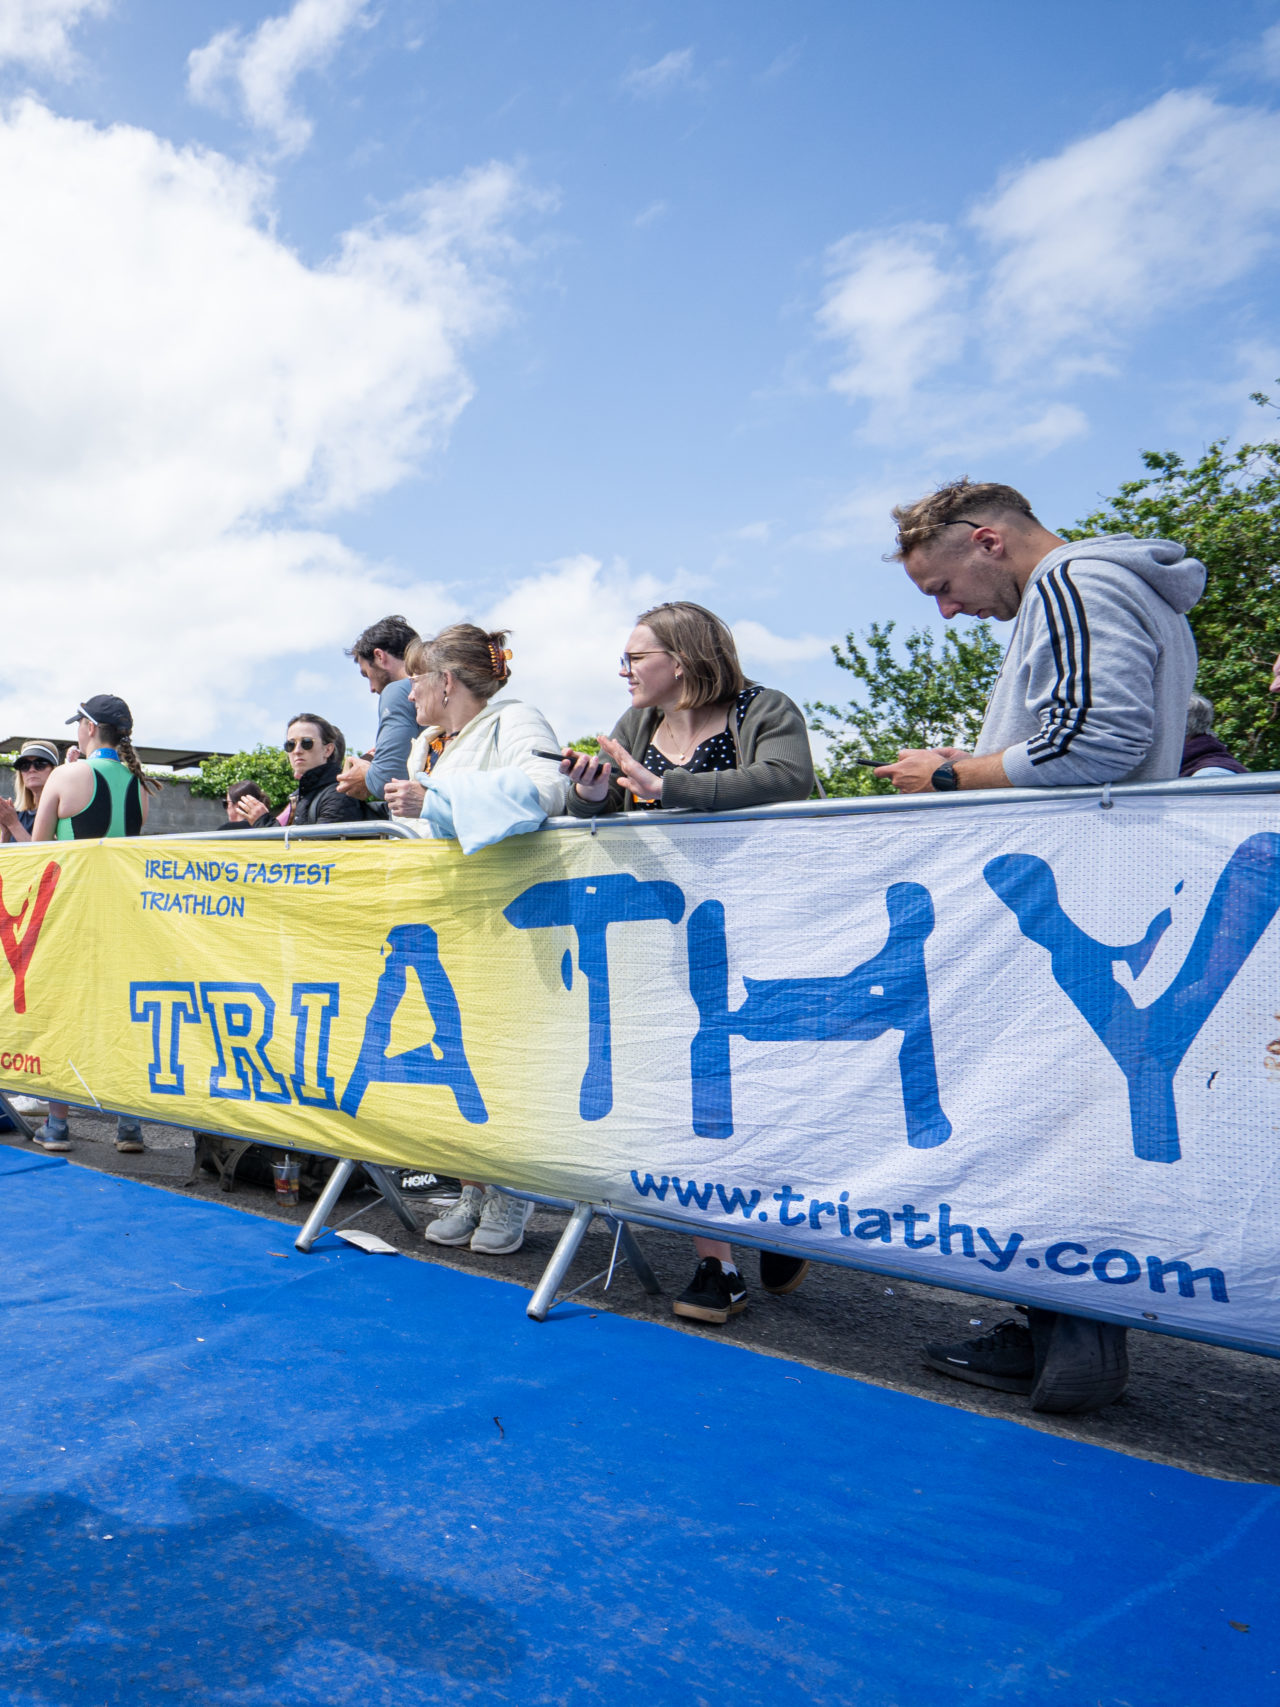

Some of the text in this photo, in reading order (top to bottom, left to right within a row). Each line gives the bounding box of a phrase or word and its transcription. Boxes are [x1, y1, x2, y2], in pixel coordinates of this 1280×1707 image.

[145, 859, 336, 885] IRELAND'S FASTEST
[140, 891, 245, 917] TRIATHLON
[129, 832, 1280, 1164] TRIATHY
[402, 1173, 437, 1188] HOKA
[630, 1169, 1230, 1303] www.triathy.com
